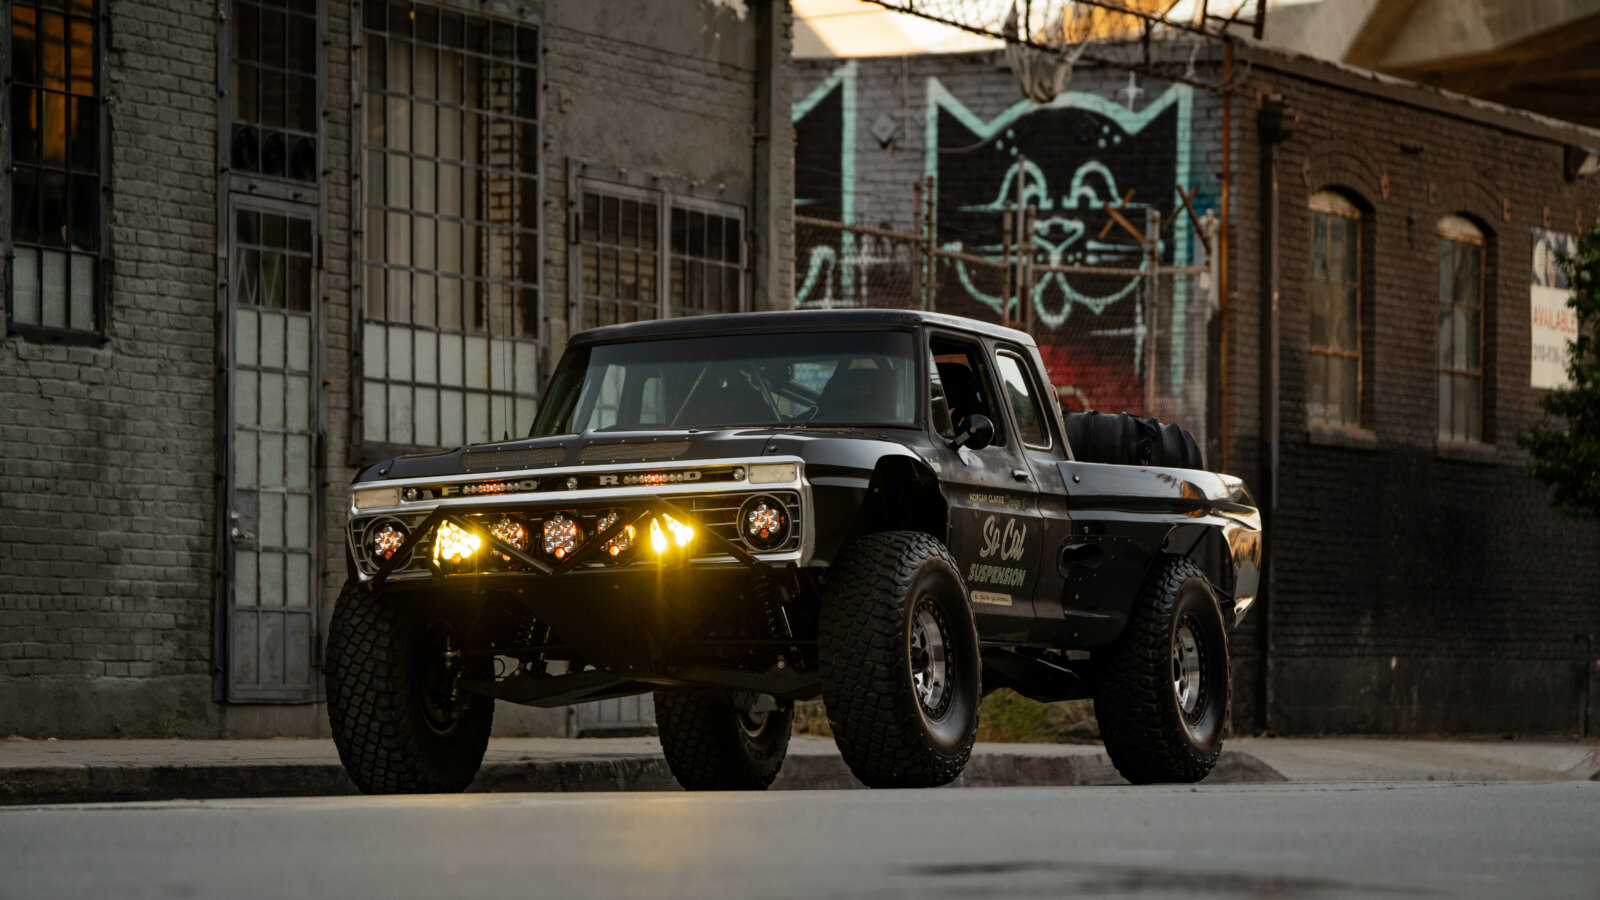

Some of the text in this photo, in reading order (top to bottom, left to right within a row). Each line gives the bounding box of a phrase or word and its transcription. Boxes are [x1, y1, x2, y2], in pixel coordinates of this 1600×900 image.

[1533, 306, 1577, 334] AVAILABLE
[980, 514, 1027, 560] So Cal
[968, 563, 1027, 587] SUSPENSION
